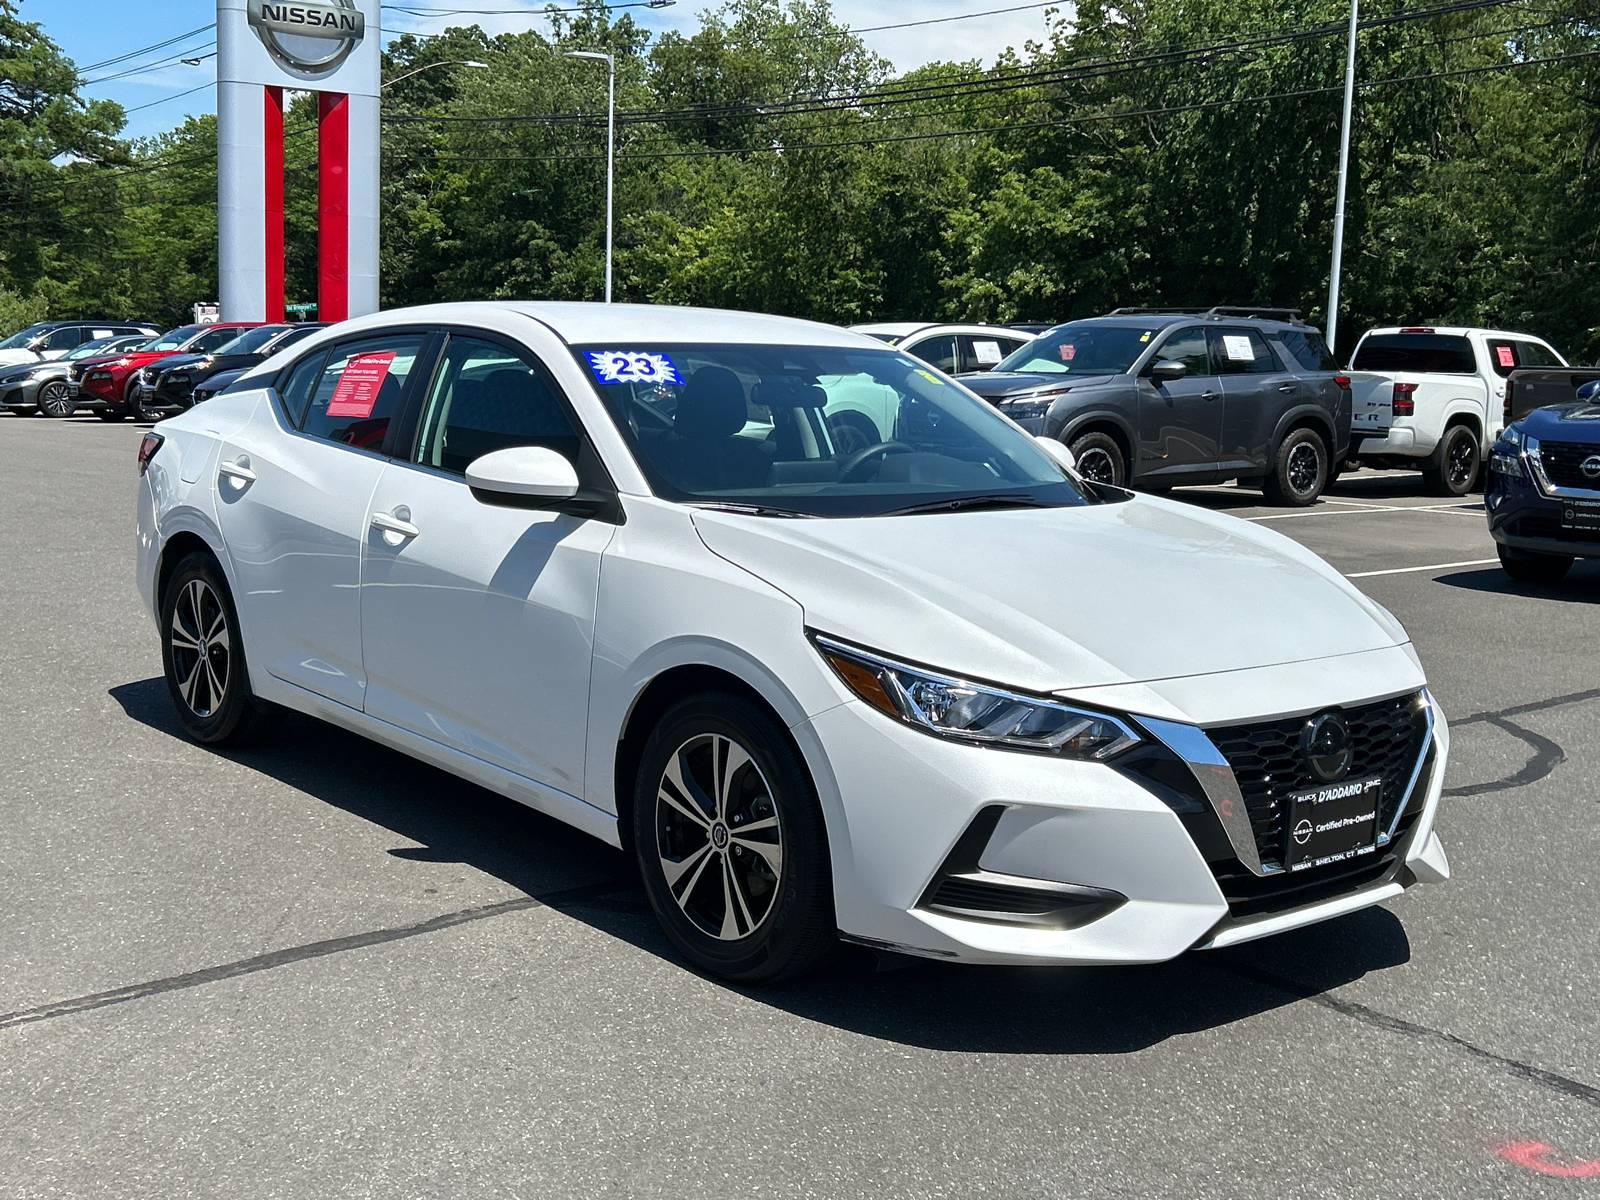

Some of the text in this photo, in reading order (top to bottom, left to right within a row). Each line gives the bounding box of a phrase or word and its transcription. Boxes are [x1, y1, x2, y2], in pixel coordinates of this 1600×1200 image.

[261, 4, 356, 32] NISSAN
[612, 357, 656, 376] 23
[1318, 784, 1362, 803] D'ADDARIO
[1293, 811, 1376, 836] NISSAN Certified Pre-Owned
[1291, 862, 1312, 872] NISSAN
[1315, 854, 1346, 866] SHELTON,
[1346, 851, 1355, 860] CT
